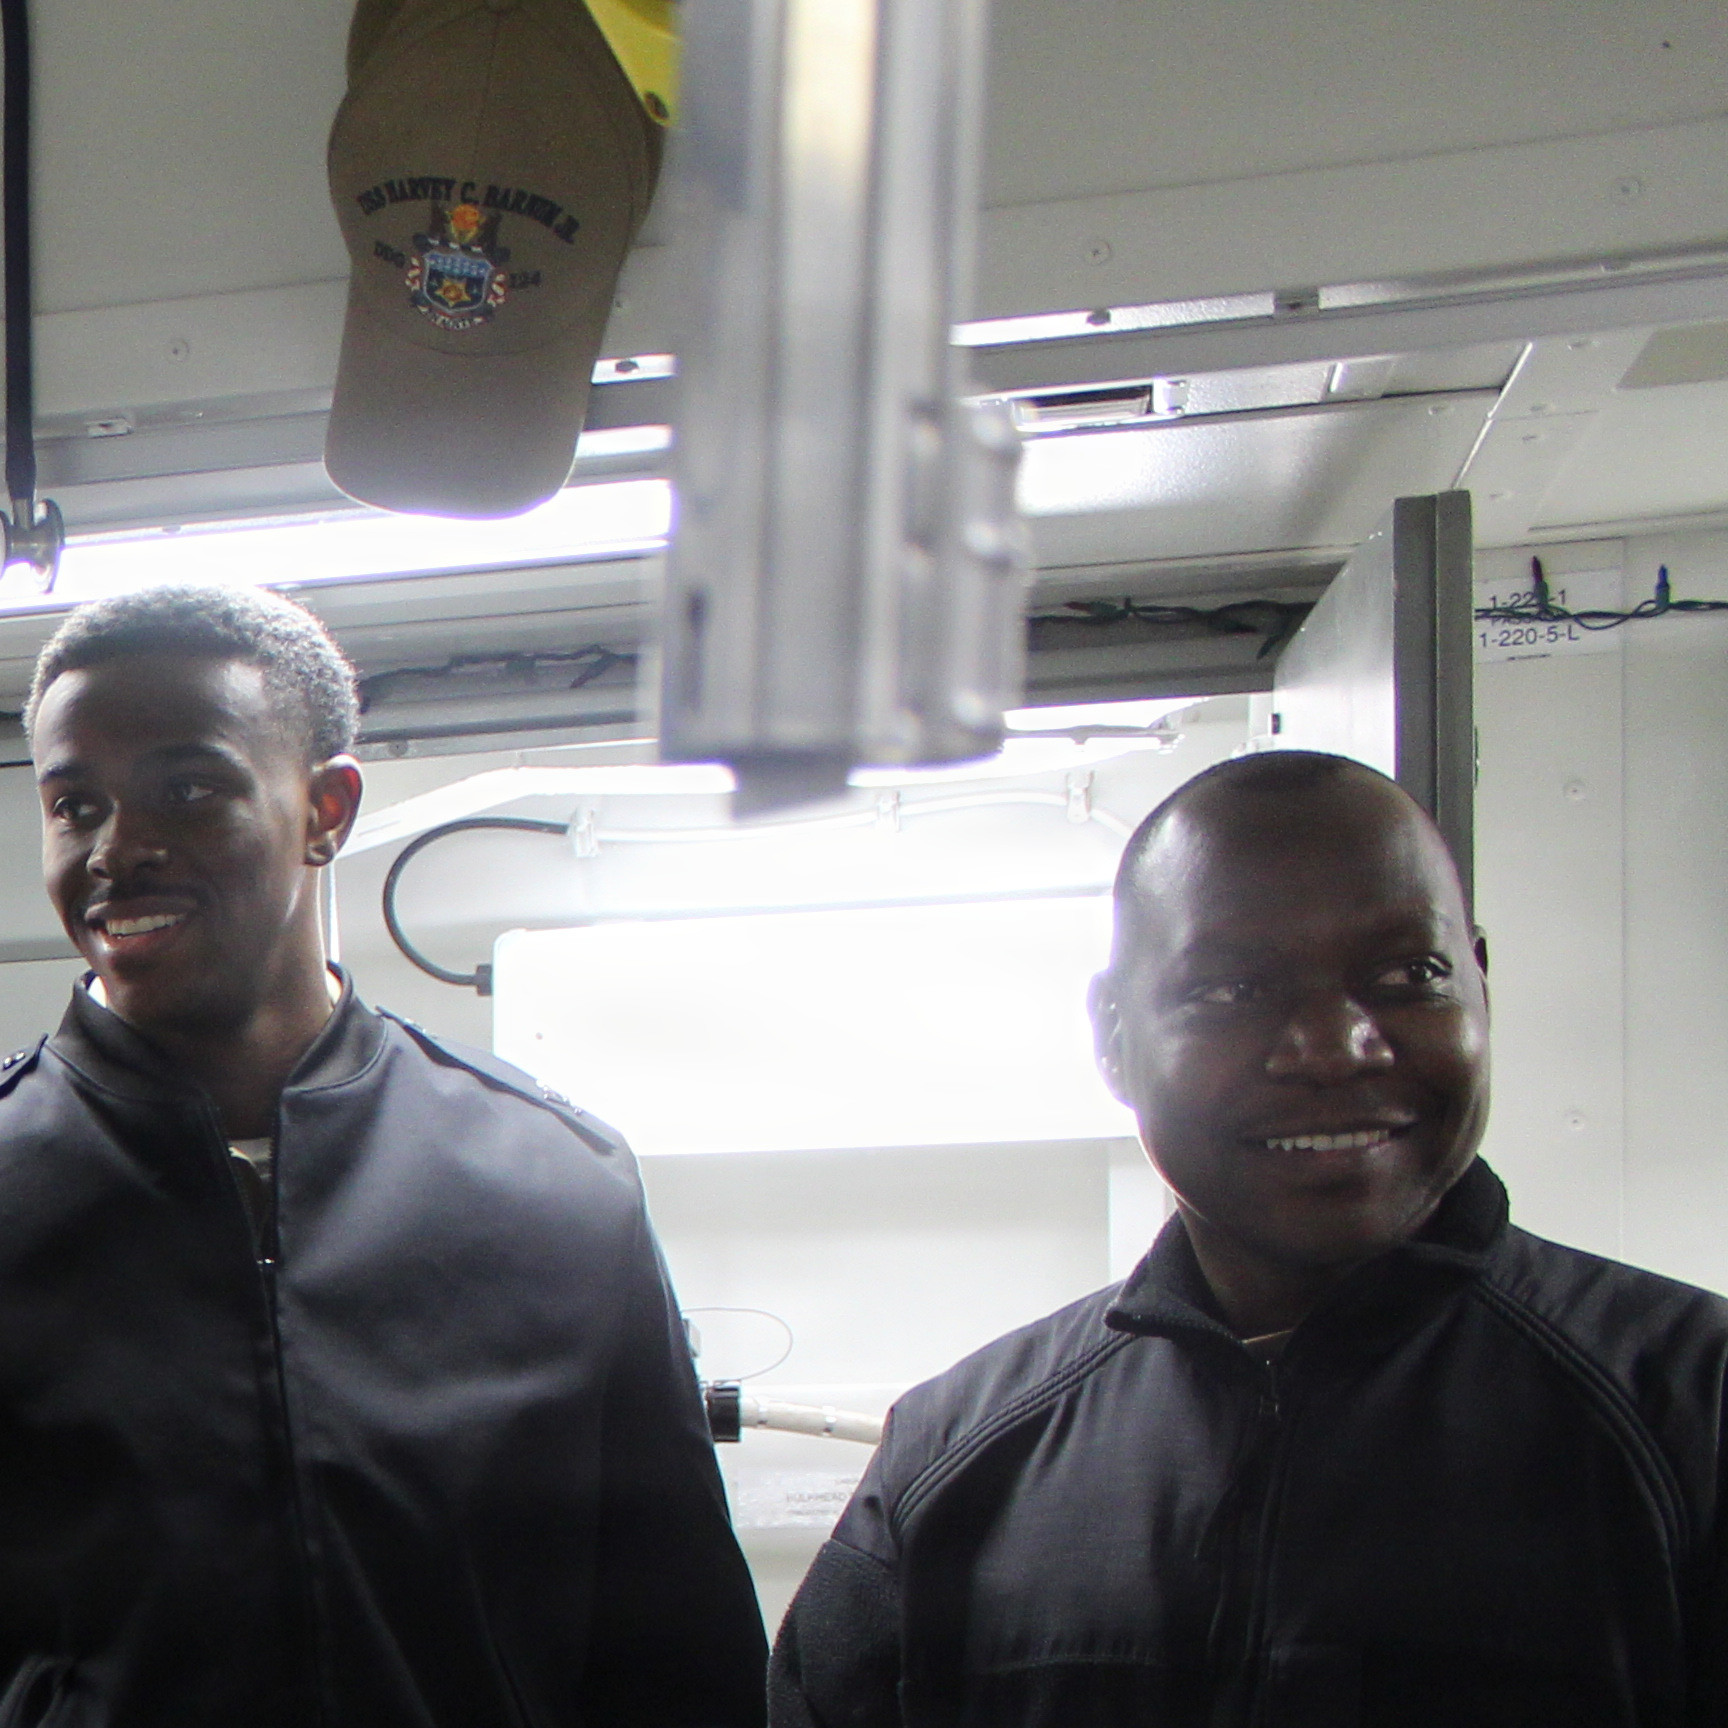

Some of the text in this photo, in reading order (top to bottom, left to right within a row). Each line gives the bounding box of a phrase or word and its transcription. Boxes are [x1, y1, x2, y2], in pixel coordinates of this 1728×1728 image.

[385, 176, 458, 202] HARVEY
[1489, 588, 1567, 609] 1-22-1
[1479, 624, 1581, 648] 1-220-5-L
